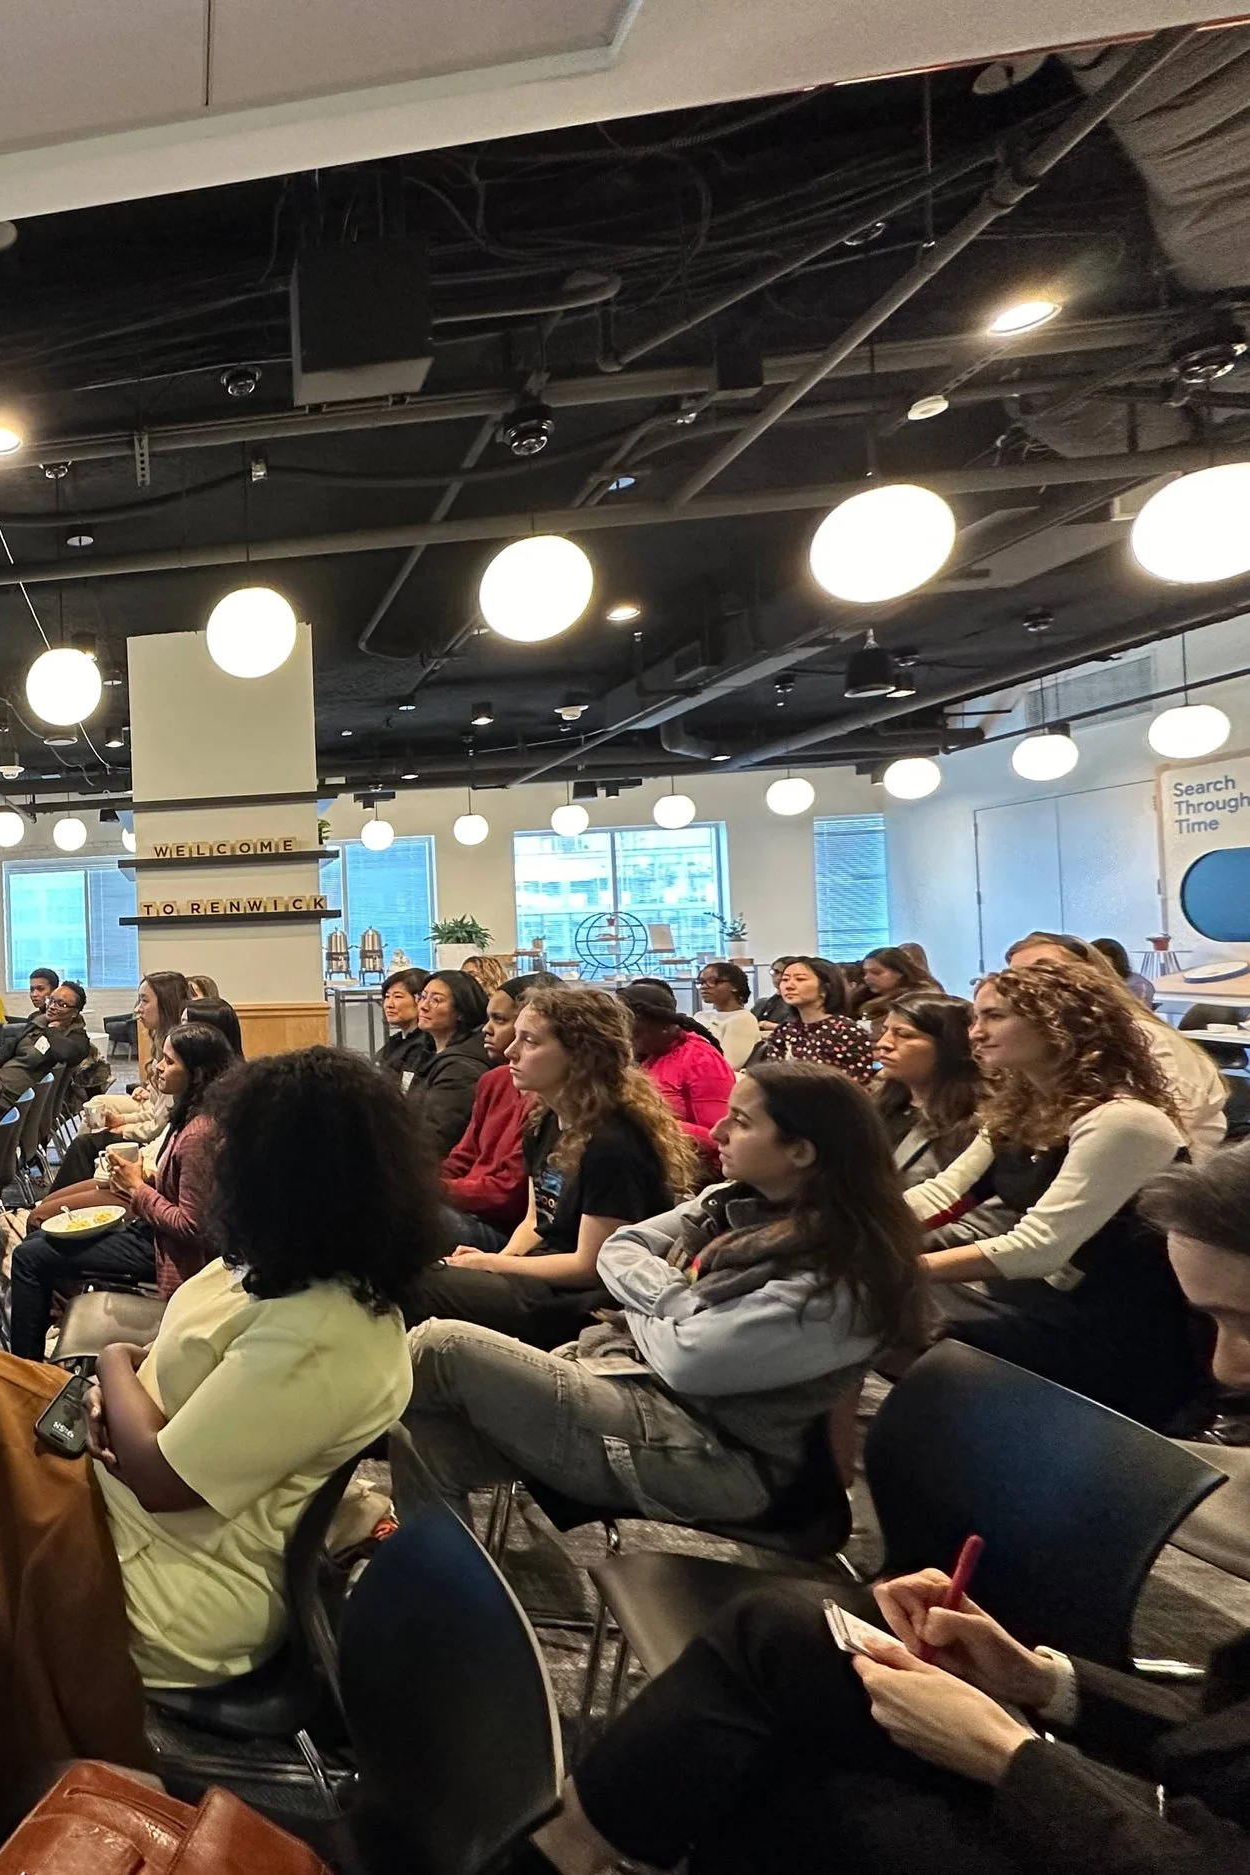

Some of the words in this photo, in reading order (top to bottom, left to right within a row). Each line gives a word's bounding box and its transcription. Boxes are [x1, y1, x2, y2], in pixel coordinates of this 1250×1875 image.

[1173, 775, 1236, 797] Search
[1174, 792, 1250, 815] Through
[1174, 818, 1219, 834] Time
[154, 839, 293, 858] WELCOME
[144, 903, 174, 916] TO
[191, 897, 325, 914] RENWICK
